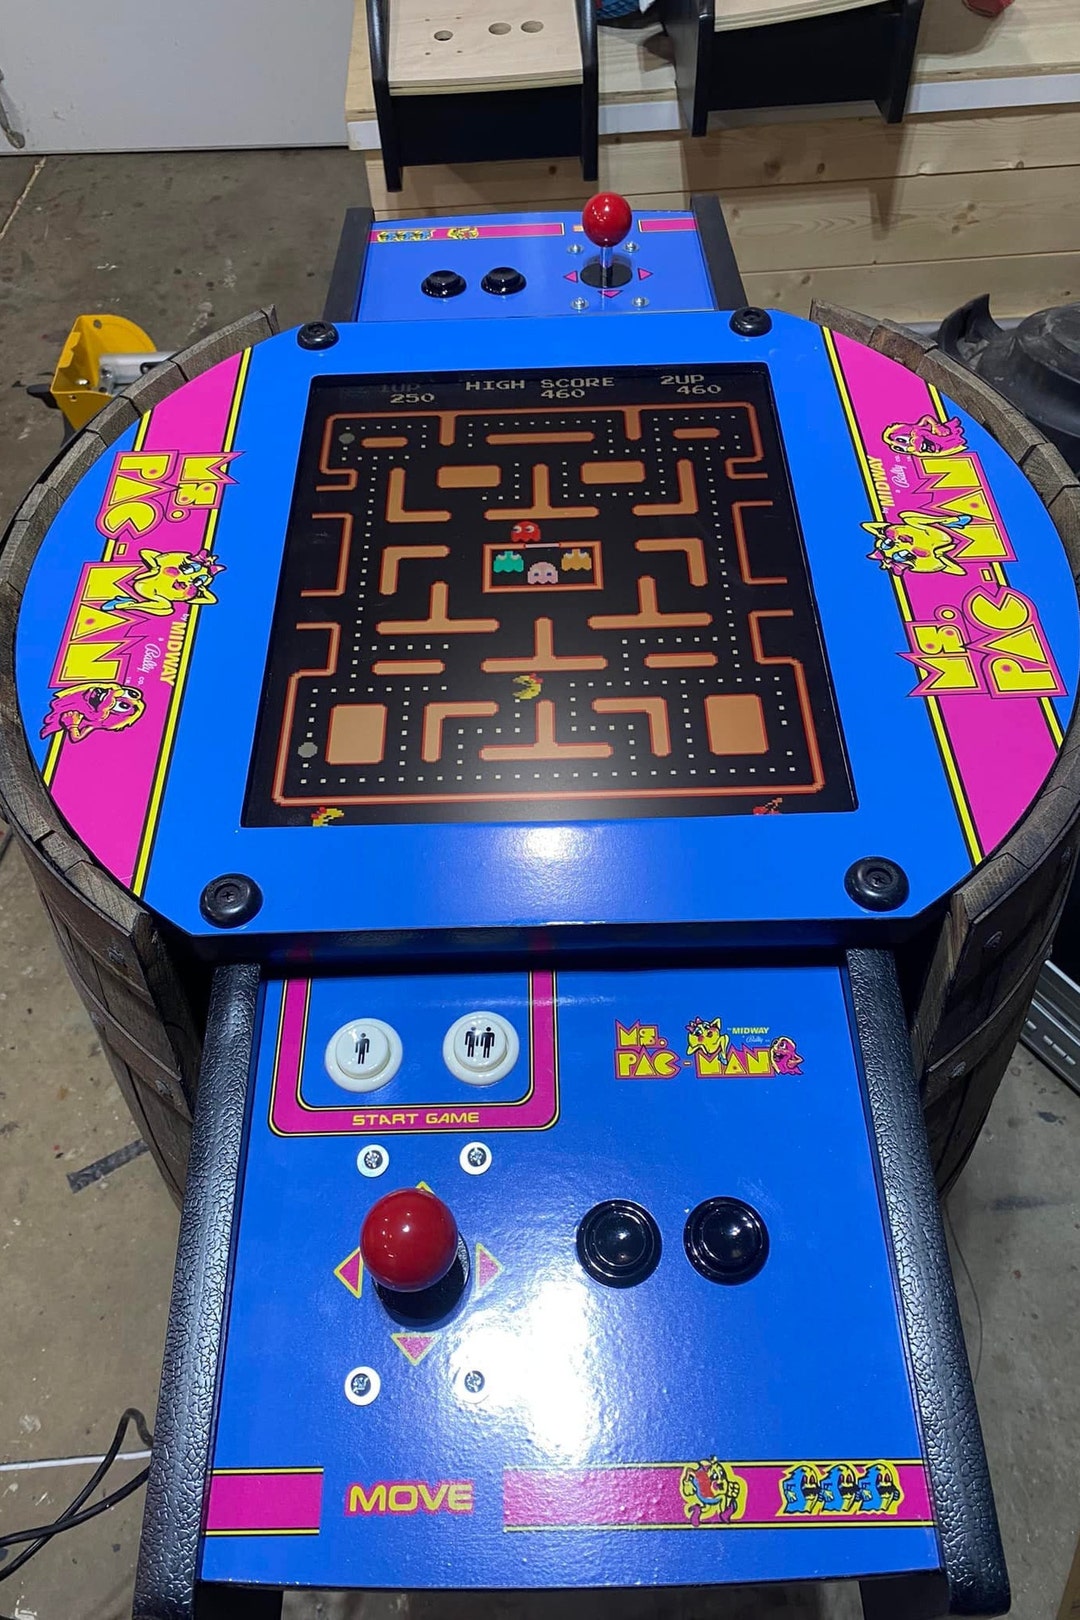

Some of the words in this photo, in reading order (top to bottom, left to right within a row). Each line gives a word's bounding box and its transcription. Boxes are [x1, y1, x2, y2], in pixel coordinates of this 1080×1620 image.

[465, 379, 525, 391] HIGH
[540, 376, 615, 389] SCORE
[660, 374, 705, 386] 2UP
[541, 388, 586, 400] 460
[676, 384, 722, 396] 460
[390, 392, 435, 404] 250
[867, 455, 895, 507] MIDWAY
[160, 621, 187, 687] MIDWAY
[731, 1026, 770, 1035] MIDWAY
[617, 1050, 772, 1078] PAC-MAN
[352, 1113, 419, 1126] START
[425, 1112, 480, 1124] GAME
[347, 1483, 474, 1513] MOVE
